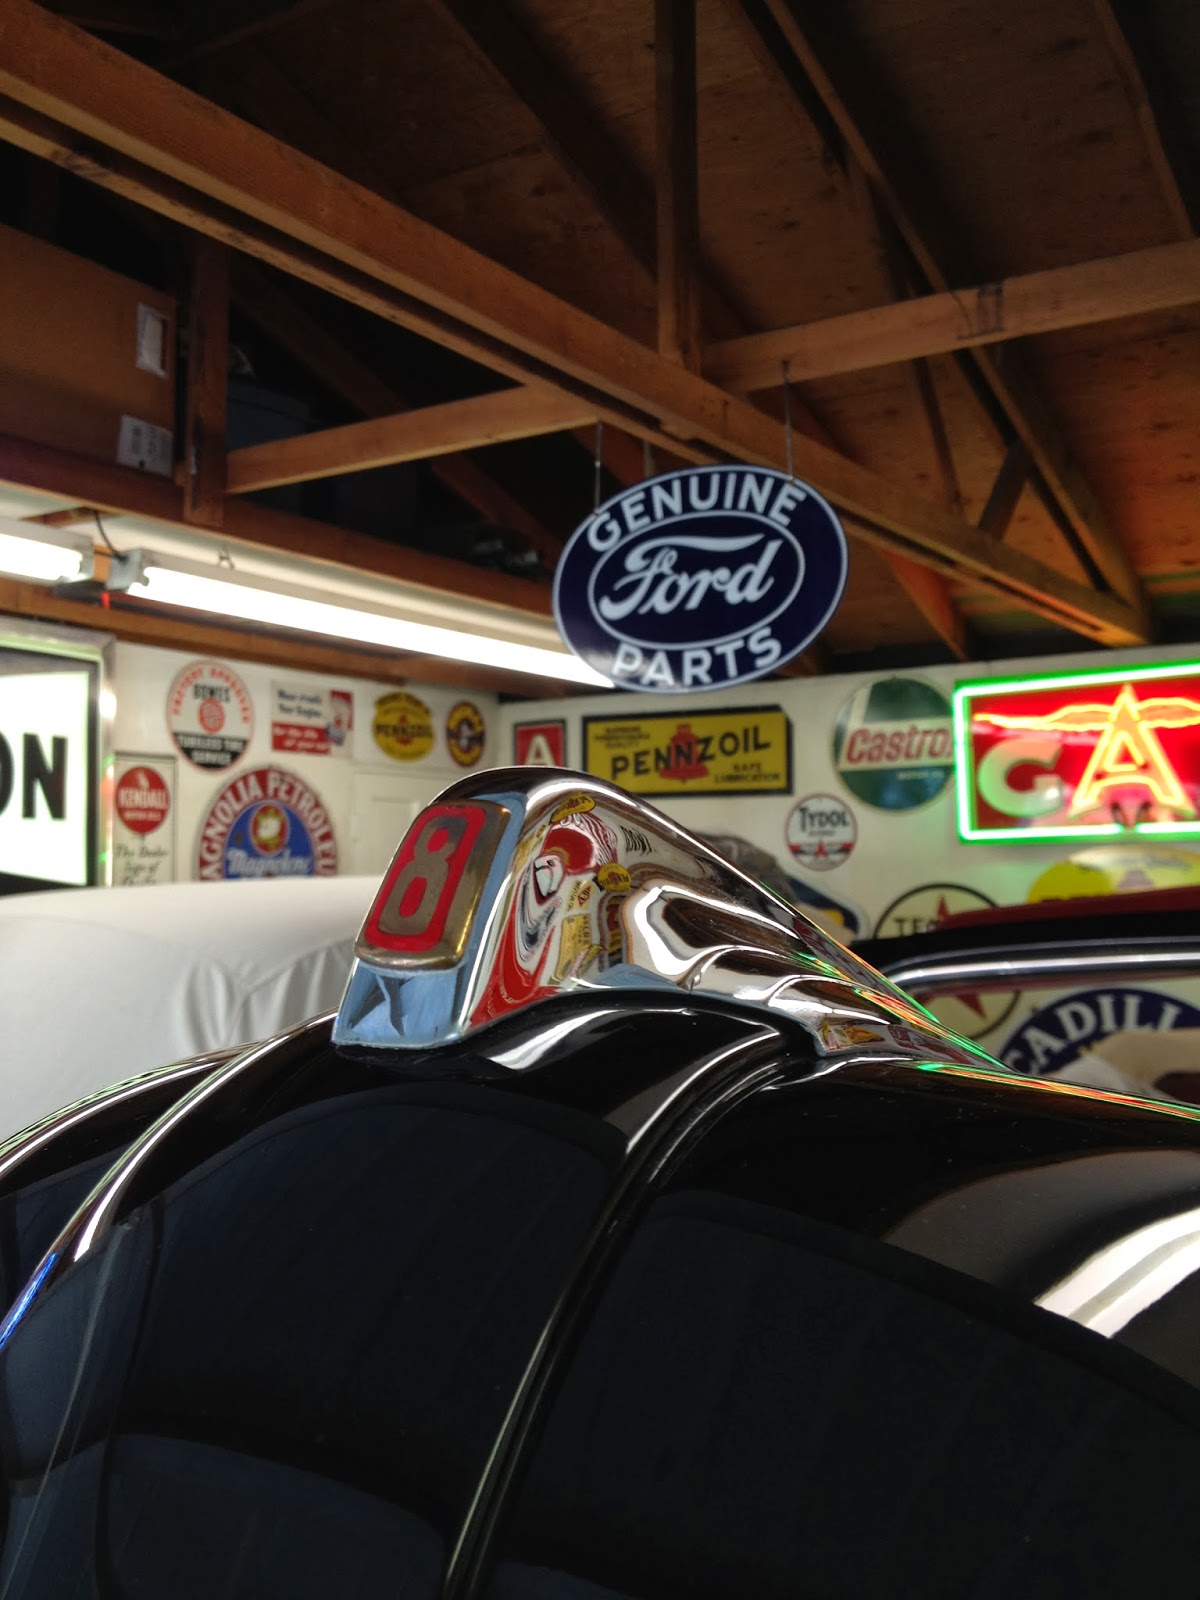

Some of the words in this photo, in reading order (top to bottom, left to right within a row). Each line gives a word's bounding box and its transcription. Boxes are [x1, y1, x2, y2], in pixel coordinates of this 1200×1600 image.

[587, 472, 806, 552] GENUINE
[600, 533, 783, 620] Ford
[611, 626, 782, 687] PARTS
[525, 735, 556, 768] A
[611, 726, 771, 781] PENNZOIL
[119, 788, 167, 810] KENDALL
[200, 773, 263, 880] AGNOLIA
[377, 815, 468, 936] 8
